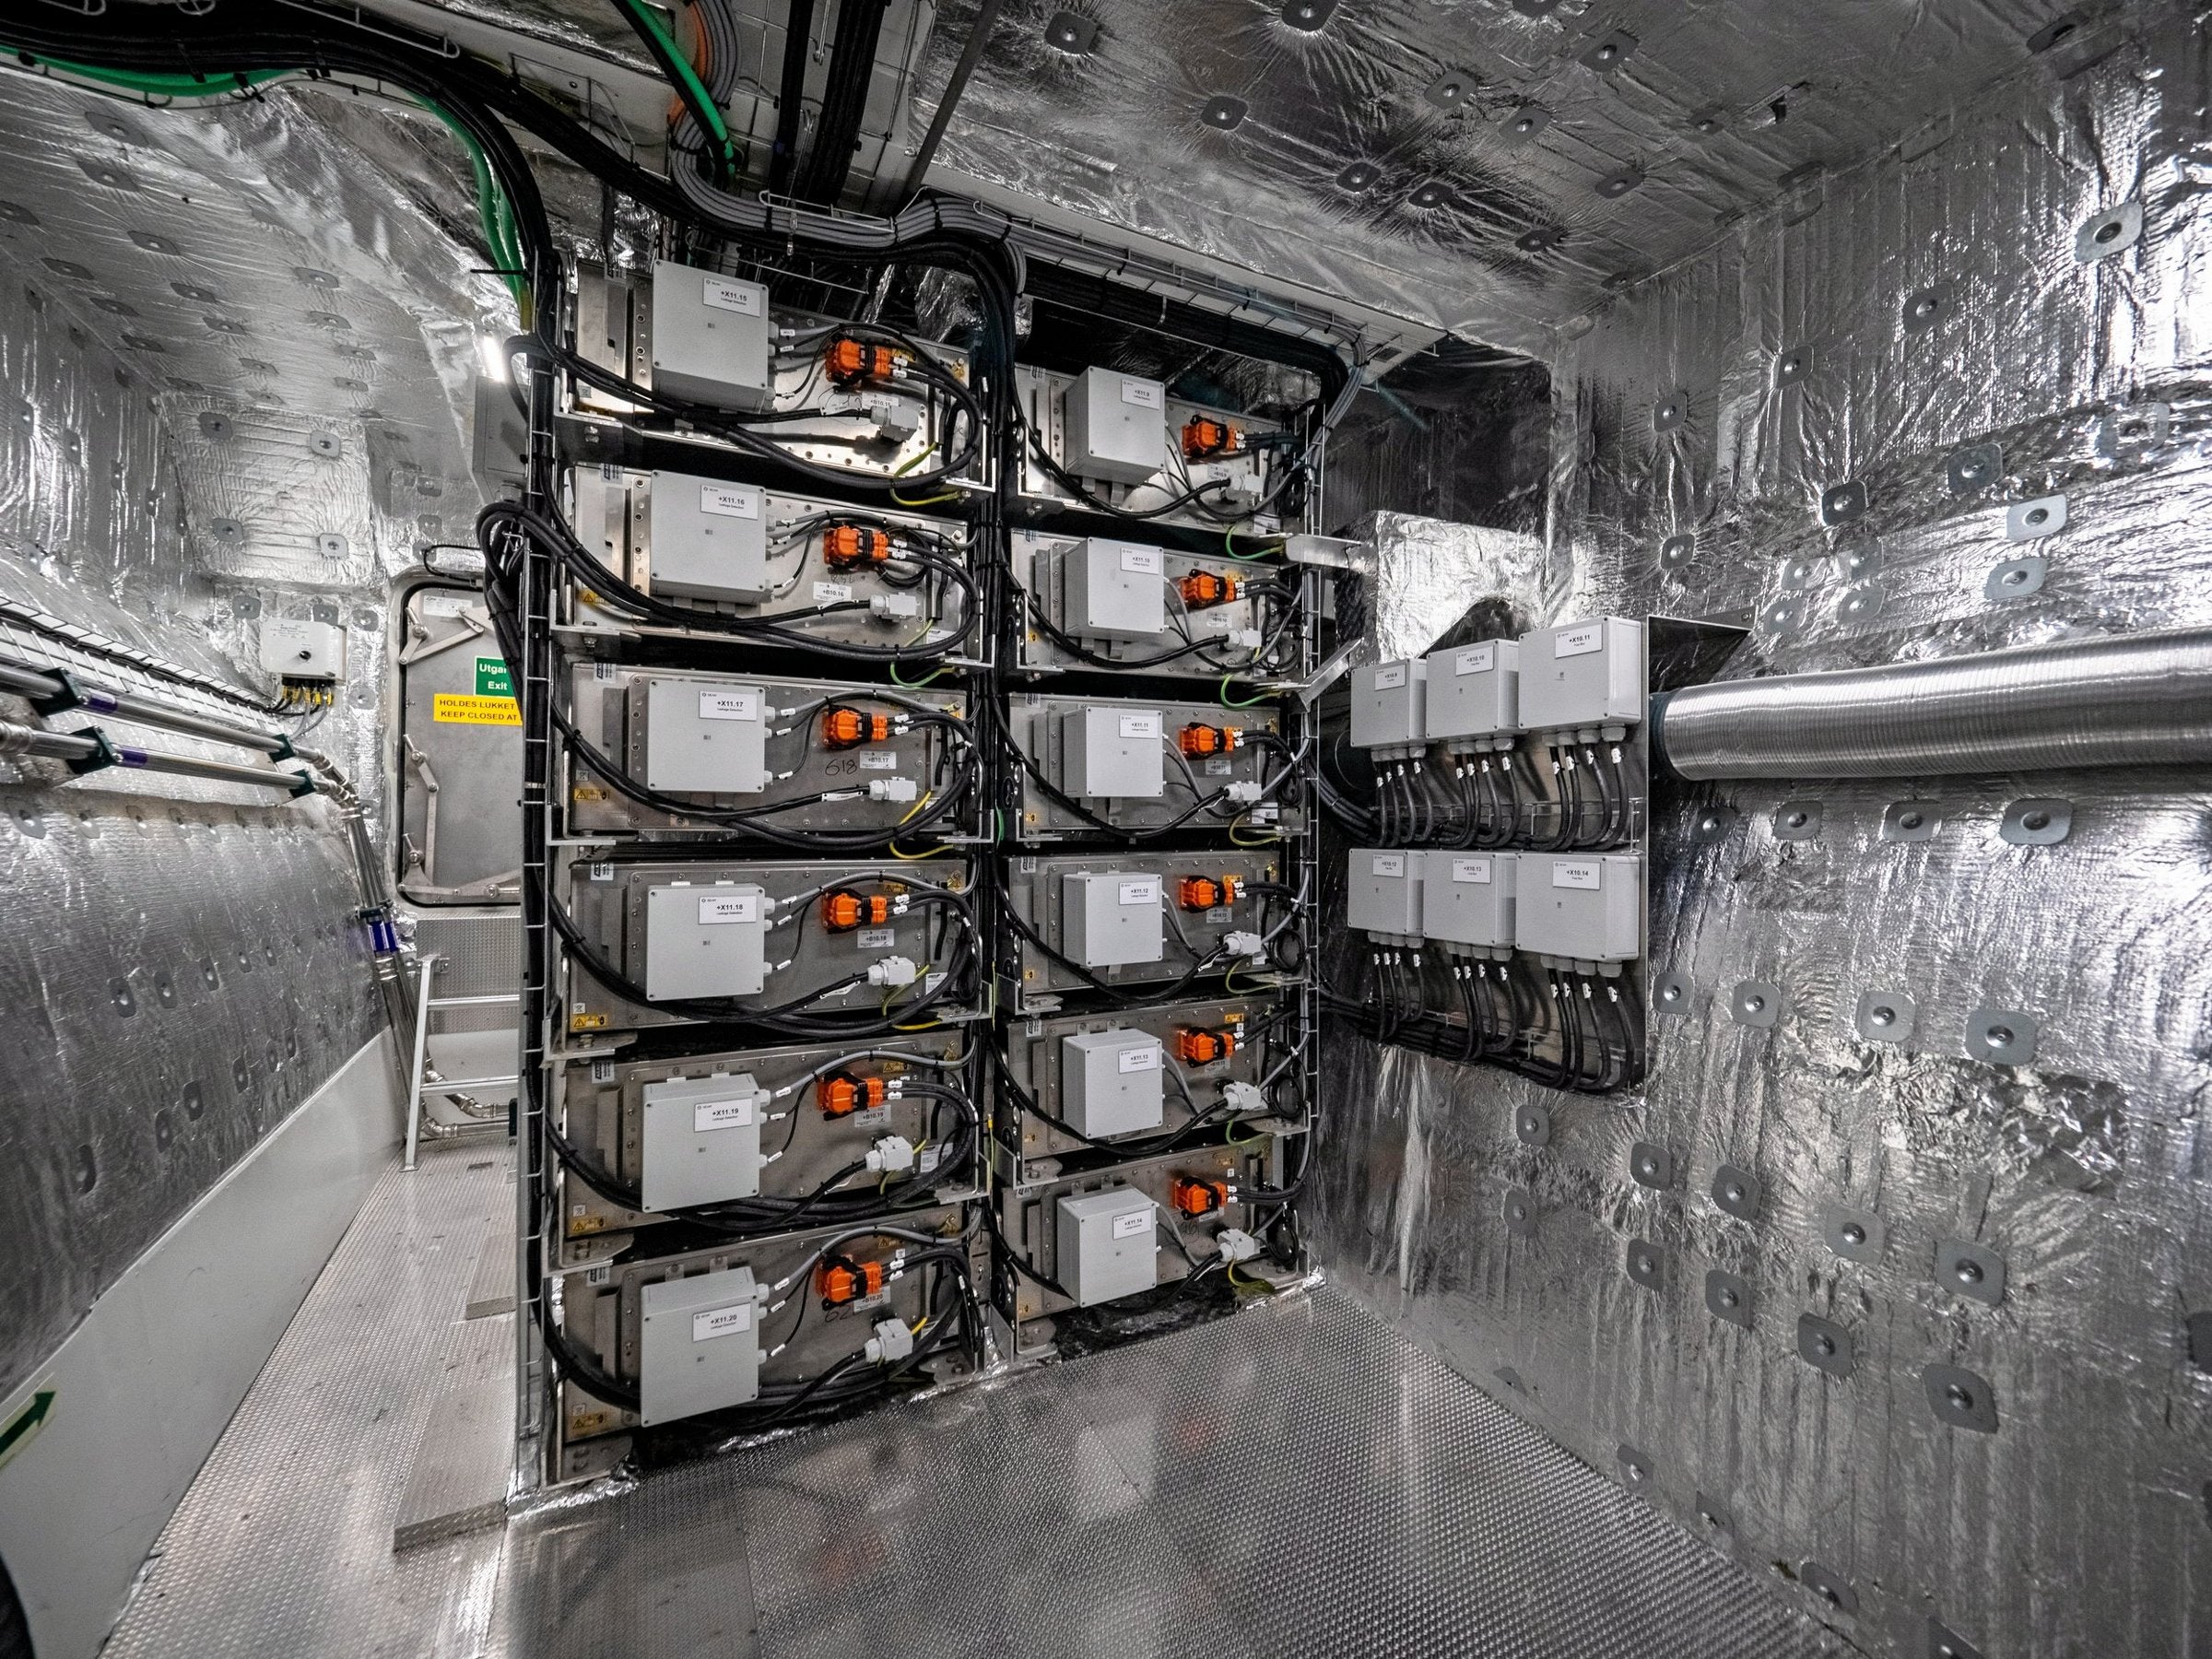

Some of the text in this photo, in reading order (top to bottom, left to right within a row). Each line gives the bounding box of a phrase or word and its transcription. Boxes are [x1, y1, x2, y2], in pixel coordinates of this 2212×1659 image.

[721, 290, 747, 301] +X11.15
[719, 496, 745, 505] +X11.16
[1570, 634, 1590, 642] +X10.11
[488, 681, 508, 689] Exit
[825, 759, 857, 776] 618
[712, 1108, 739, 1116] +X11.19
[711, 1314, 737, 1324] +X11.20
